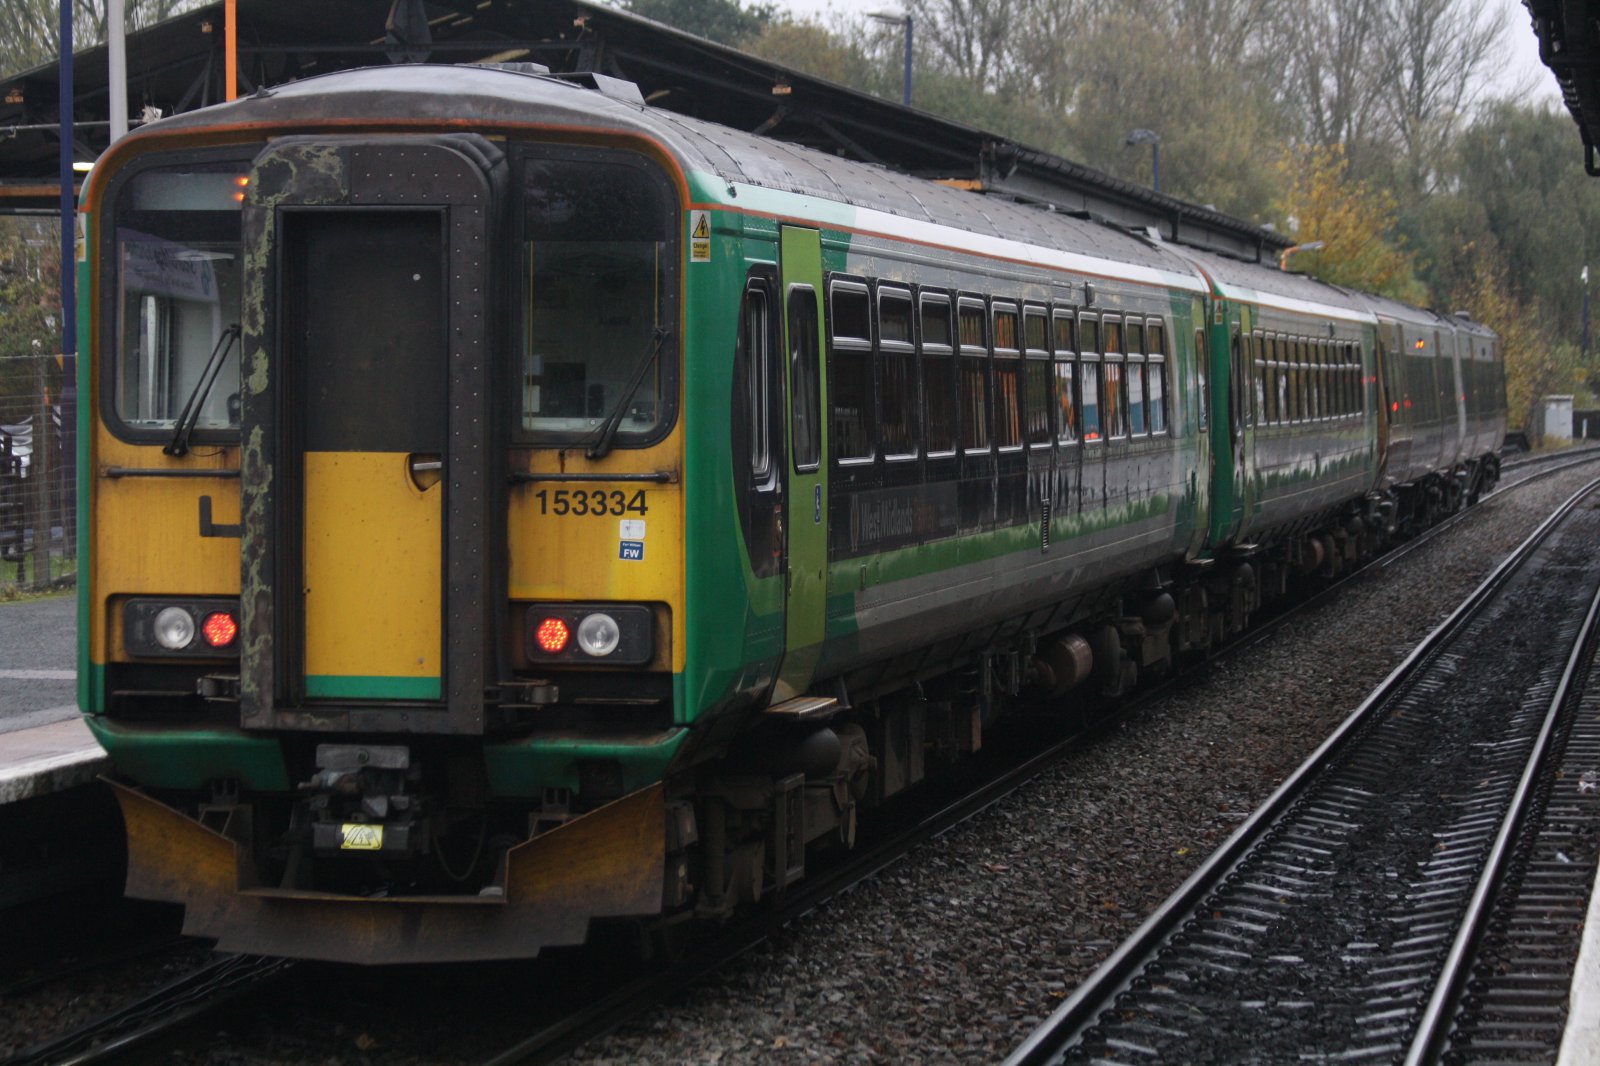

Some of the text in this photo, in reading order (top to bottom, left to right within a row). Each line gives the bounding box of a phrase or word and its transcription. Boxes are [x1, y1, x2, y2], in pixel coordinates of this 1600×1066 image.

[536, 489, 648, 516] 153334
[881, 497, 913, 537] Midlands
[624, 549, 639, 558] FW
